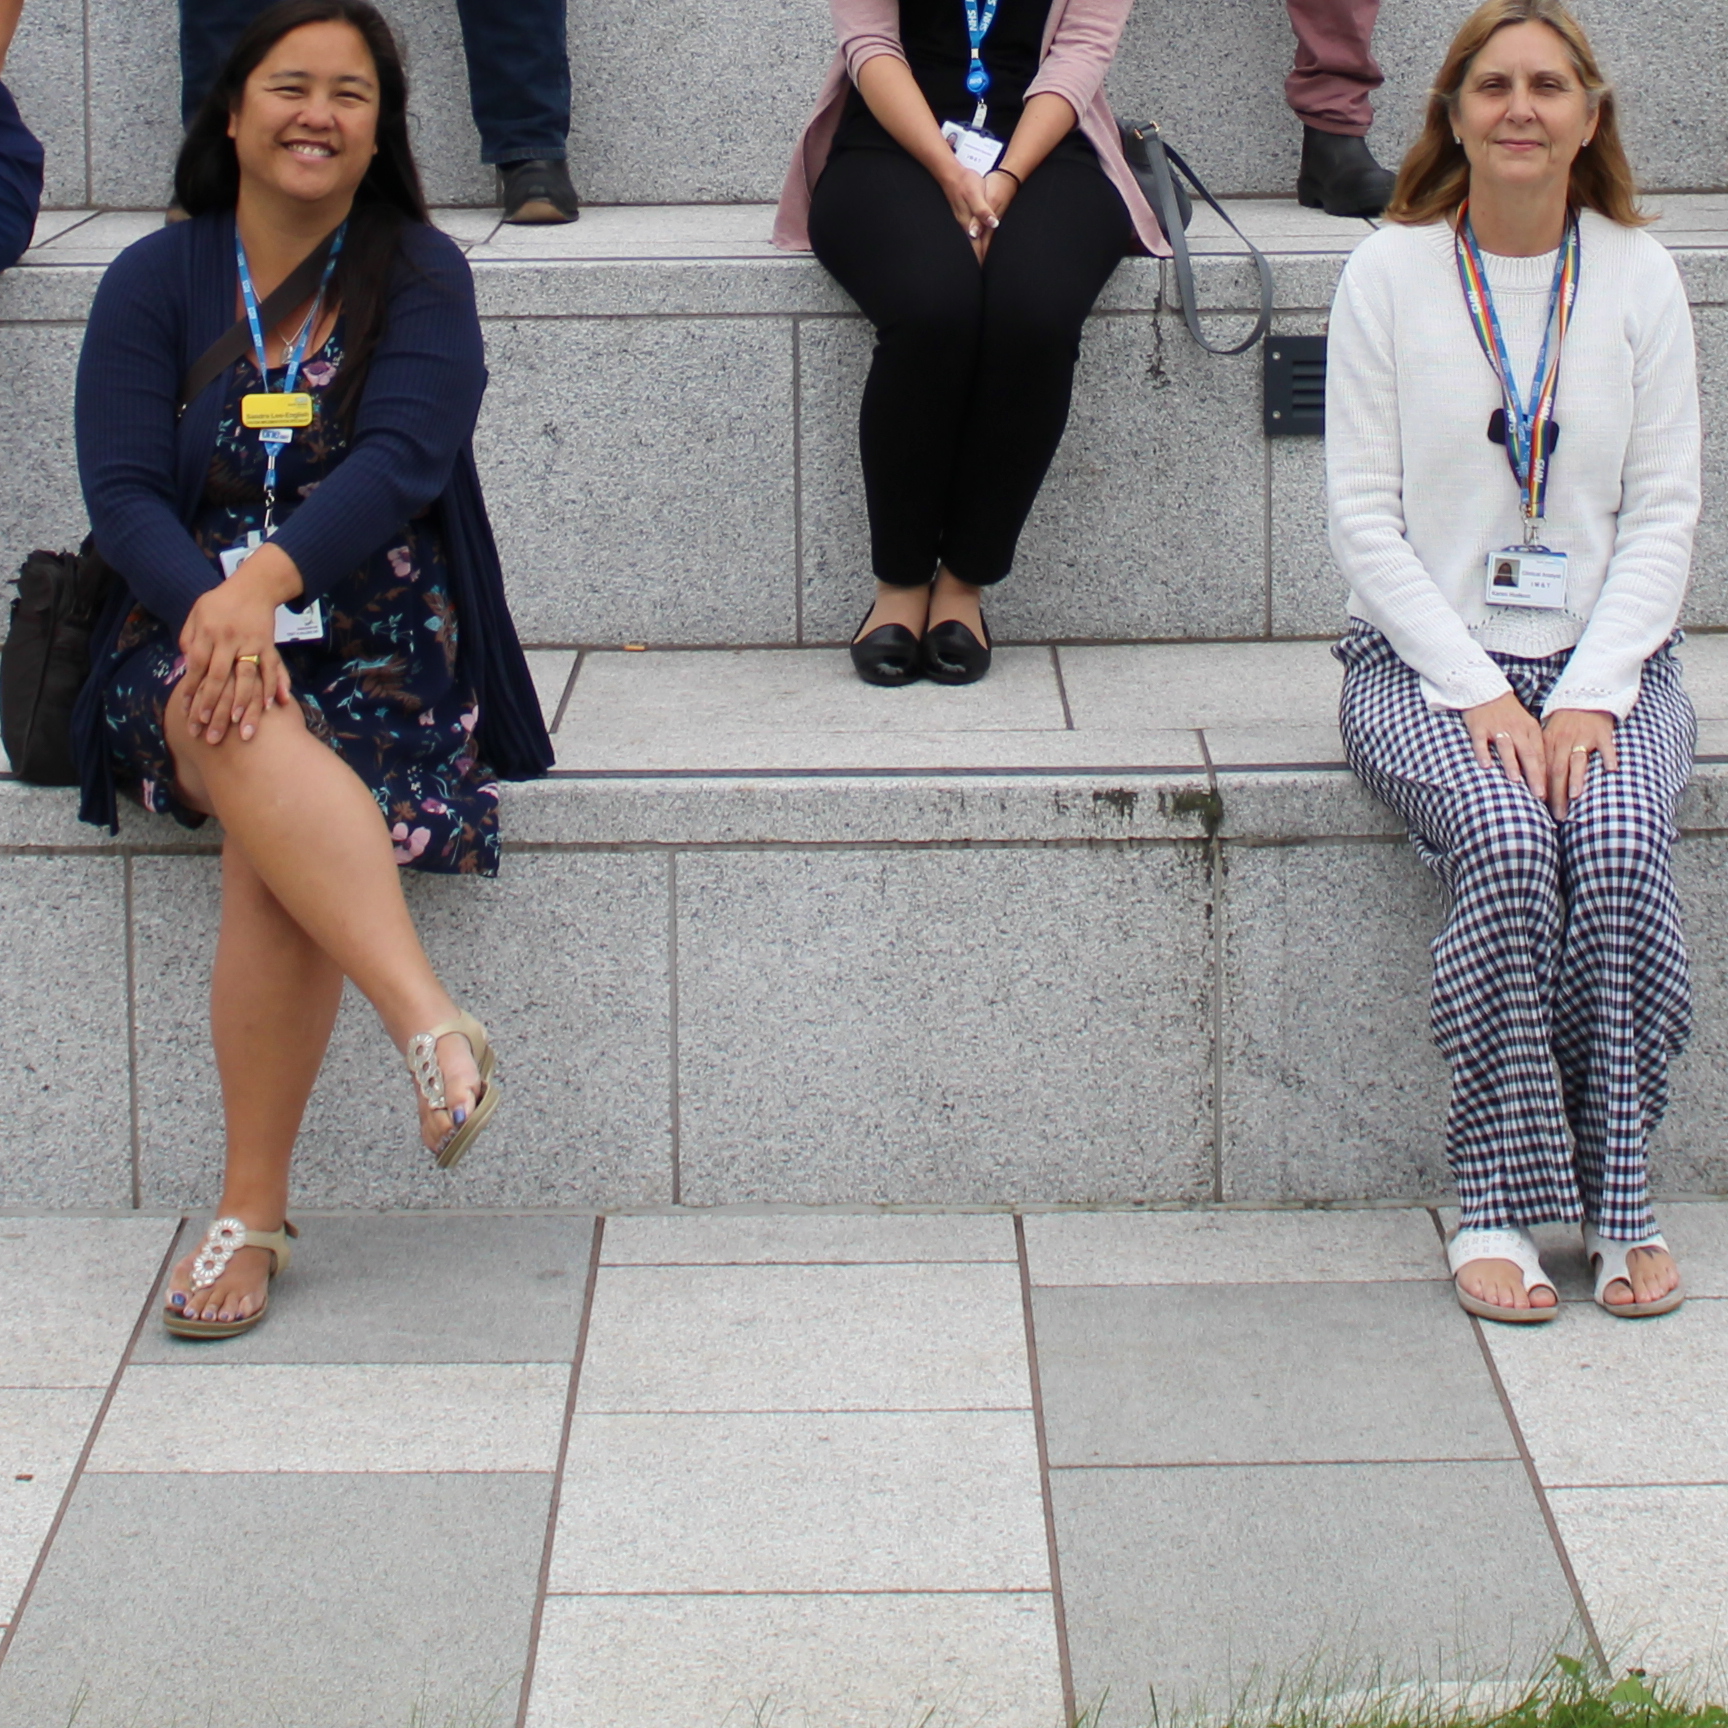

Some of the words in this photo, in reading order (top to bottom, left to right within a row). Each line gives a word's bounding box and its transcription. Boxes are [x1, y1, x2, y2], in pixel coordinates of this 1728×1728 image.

[967, 9, 978, 31] NHS
[979, 12, 993, 31] NHS
[1564, 282, 1575, 306] NHS
[1539, 396, 1552, 420] NHS
[1534, 458, 1545, 482] NHS
